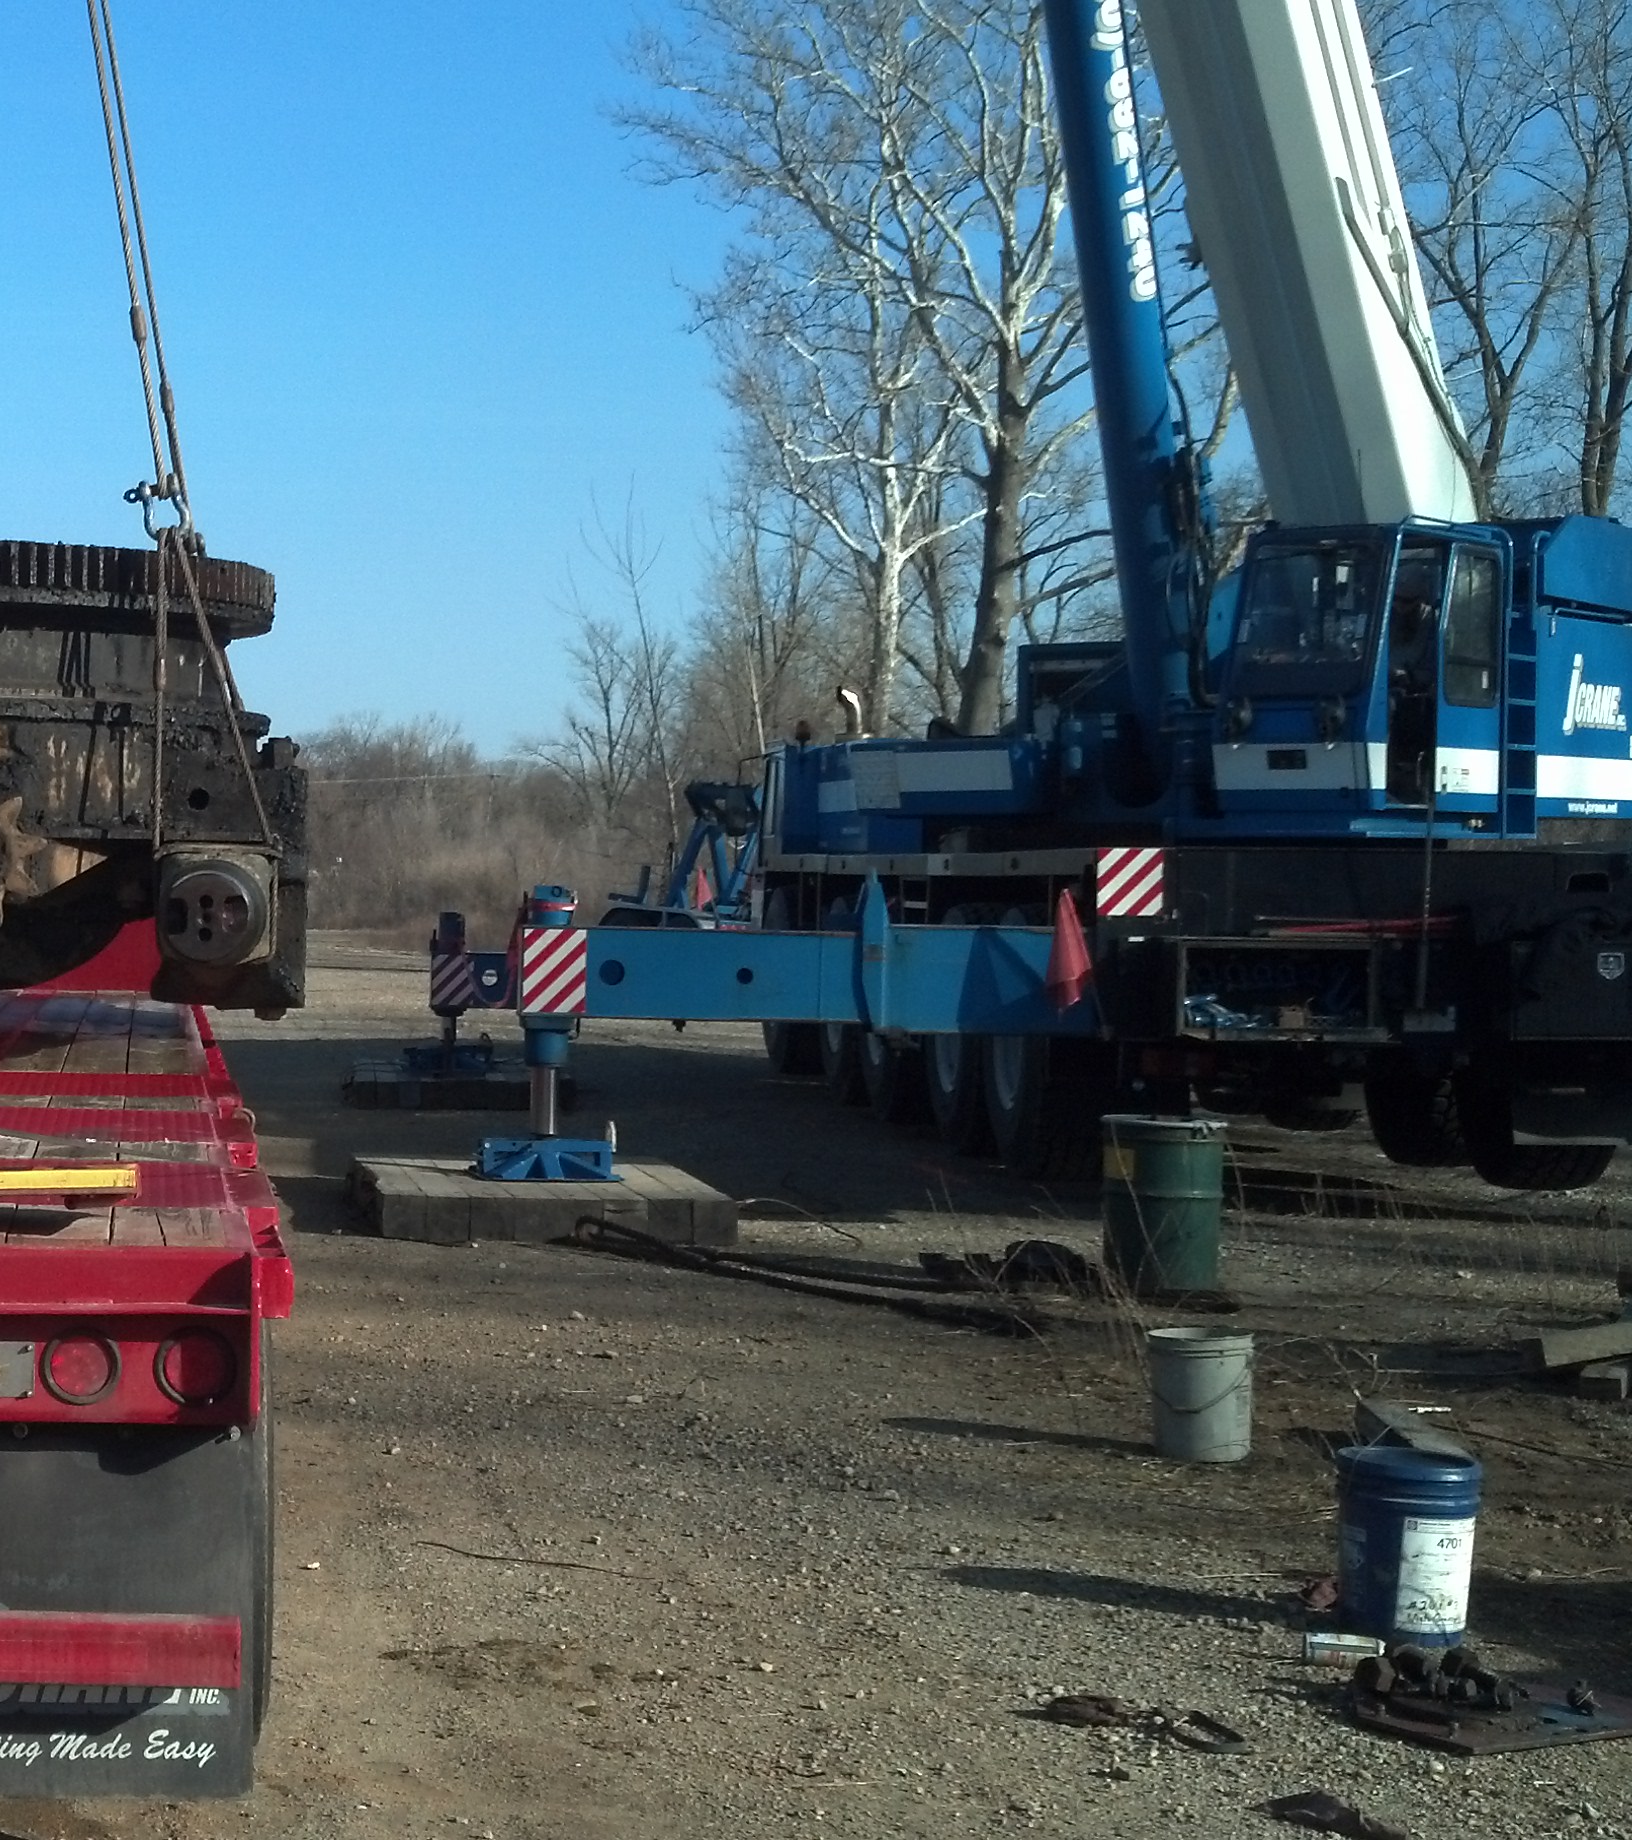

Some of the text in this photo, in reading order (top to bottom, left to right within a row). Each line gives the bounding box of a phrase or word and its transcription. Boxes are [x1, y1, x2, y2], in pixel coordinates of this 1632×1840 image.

[189, 1688, 220, 1704] INC.
[49, 1733, 132, 1760] Made
[143, 1729, 217, 1768] Easy
